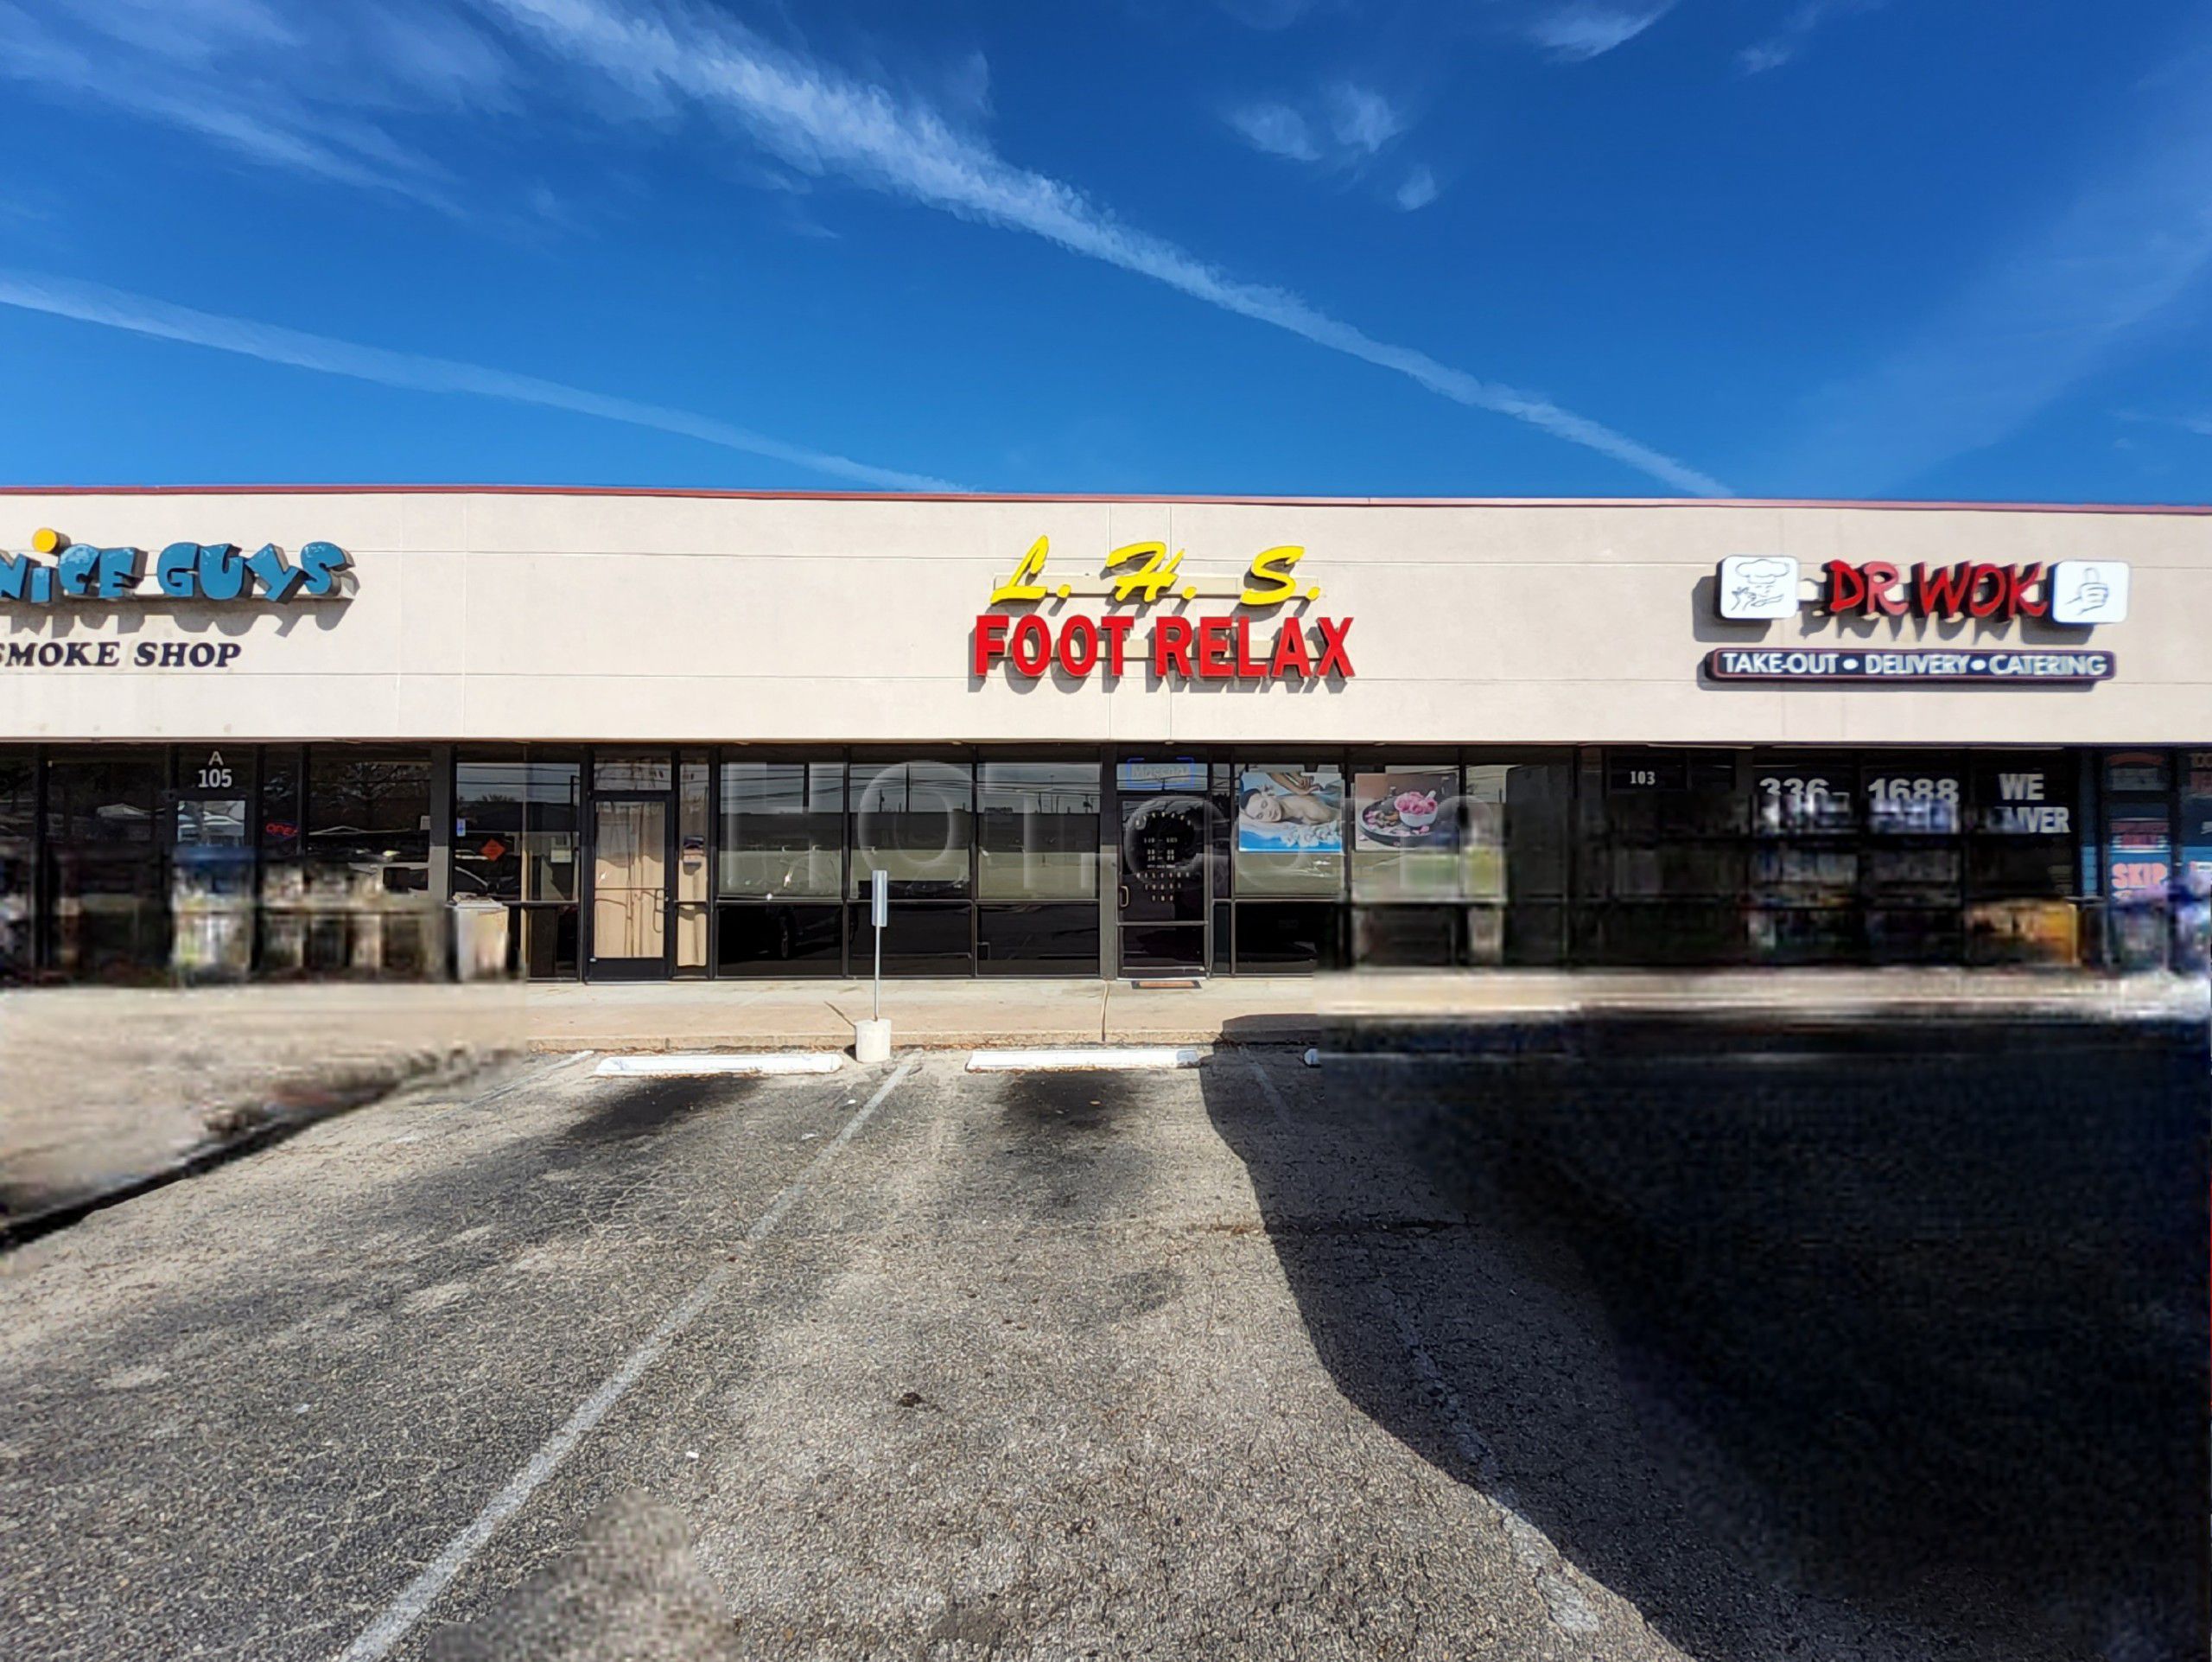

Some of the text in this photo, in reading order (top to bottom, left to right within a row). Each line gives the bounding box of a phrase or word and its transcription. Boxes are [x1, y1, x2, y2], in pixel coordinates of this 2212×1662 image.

[156, 541, 353, 604] GUYS
[1916, 559, 2049, 619] WOK
[0, 641, 242, 668] MOKE SHOP
[974, 614, 1356, 678] FOOT RELAX
[1722, 652, 2107, 678] TAKE-OUT DELIVERY CATERING
[208, 750, 225, 767] A
[197, 767, 233, 788] 105
[1630, 770, 1656, 786] 103
[1998, 773, 2045, 800] WE
[1868, 778, 1960, 805] 1688
[2111, 862, 2168, 889] SKIP
